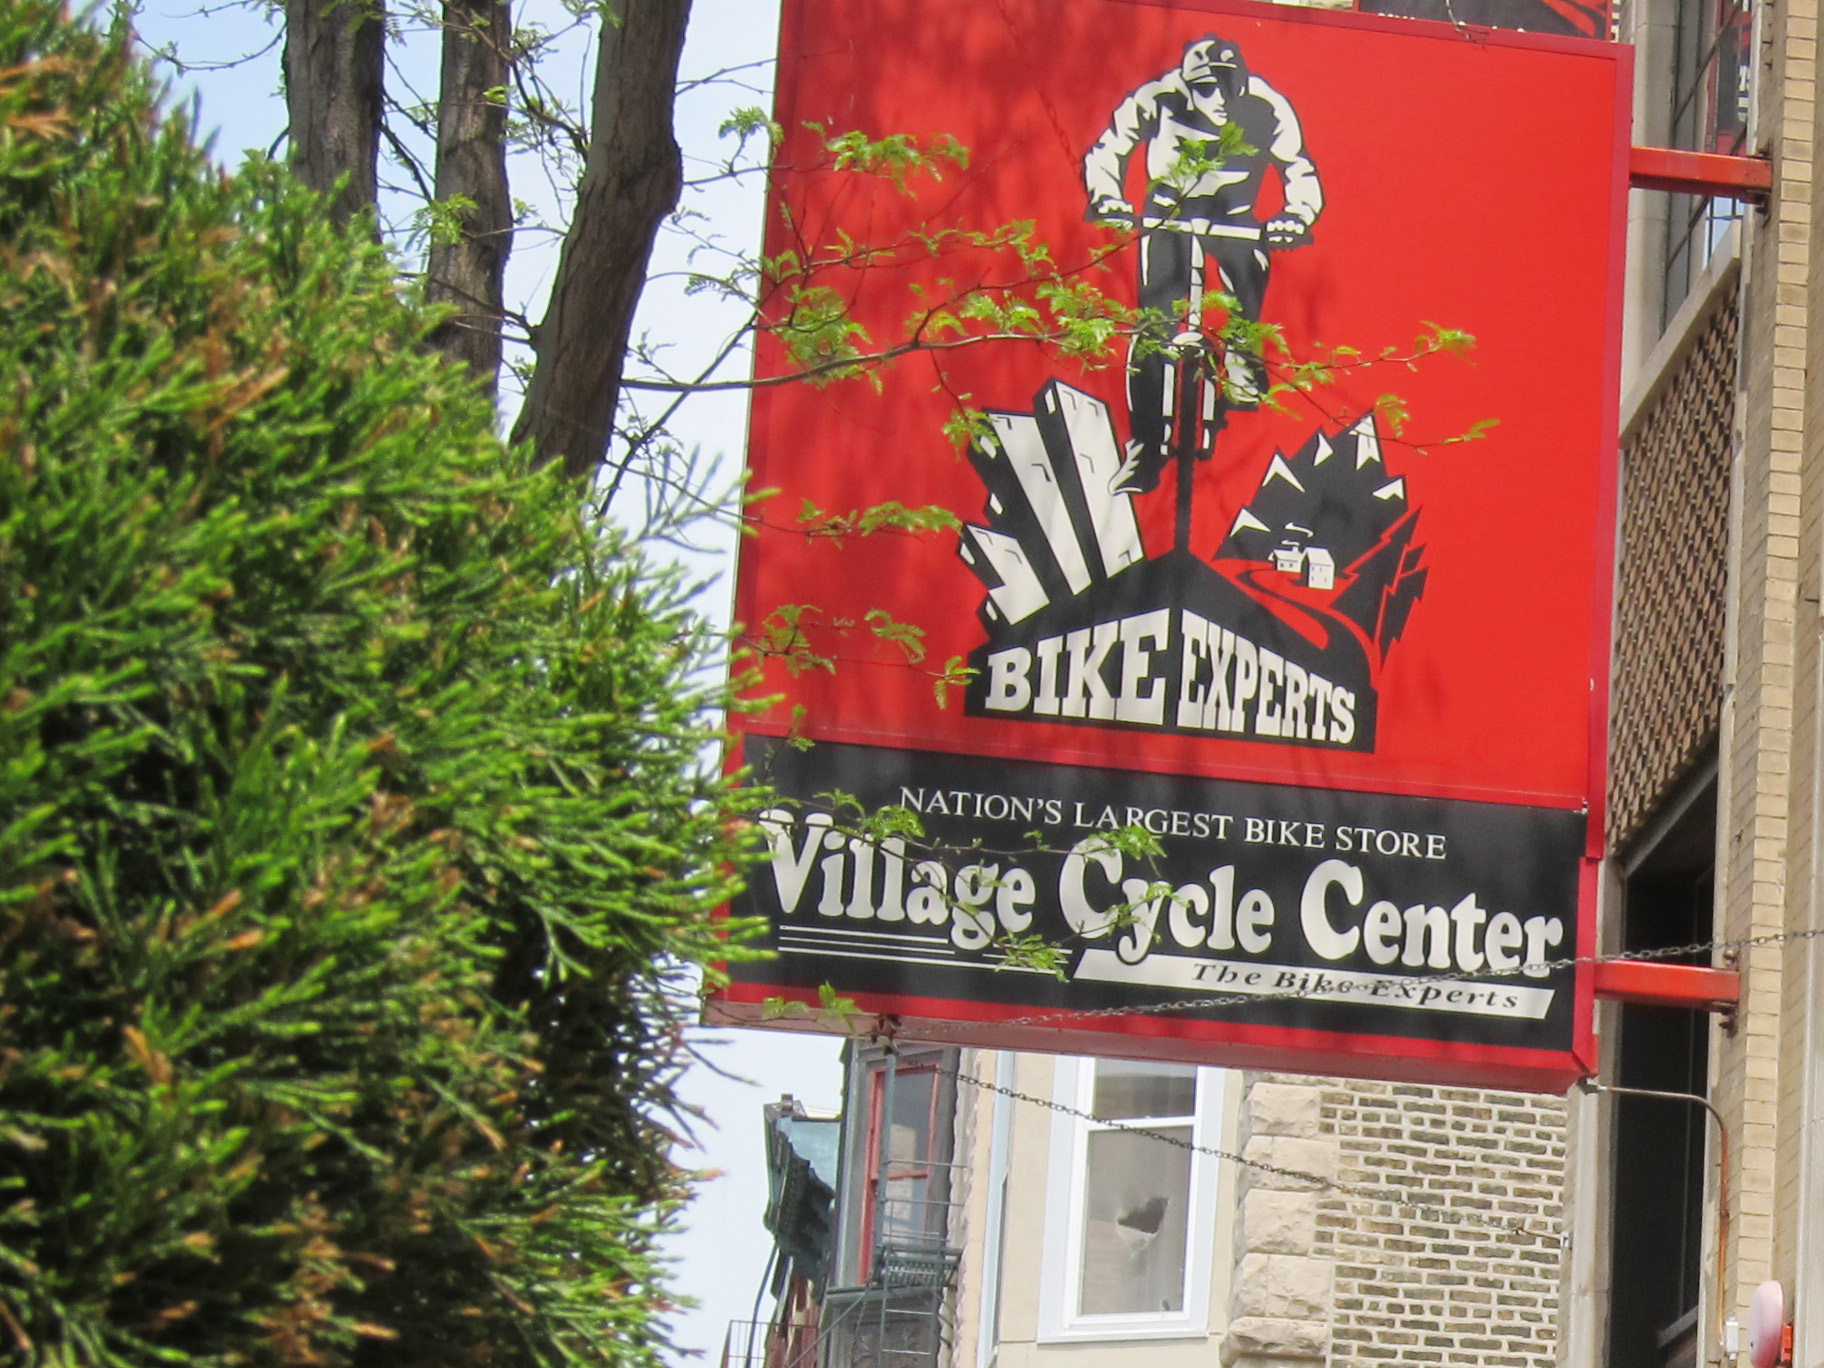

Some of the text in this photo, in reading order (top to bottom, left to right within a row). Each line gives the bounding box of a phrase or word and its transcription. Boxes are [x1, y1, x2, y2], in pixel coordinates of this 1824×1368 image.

[984, 608, 1356, 746] BIKE EXPERTS
[900, 787, 1447, 859] NATION'S LARGEST BIKE STORE
[758, 808, 1563, 978] Village Cycle Center
[1191, 963, 1520, 1011] The Bike Experts
